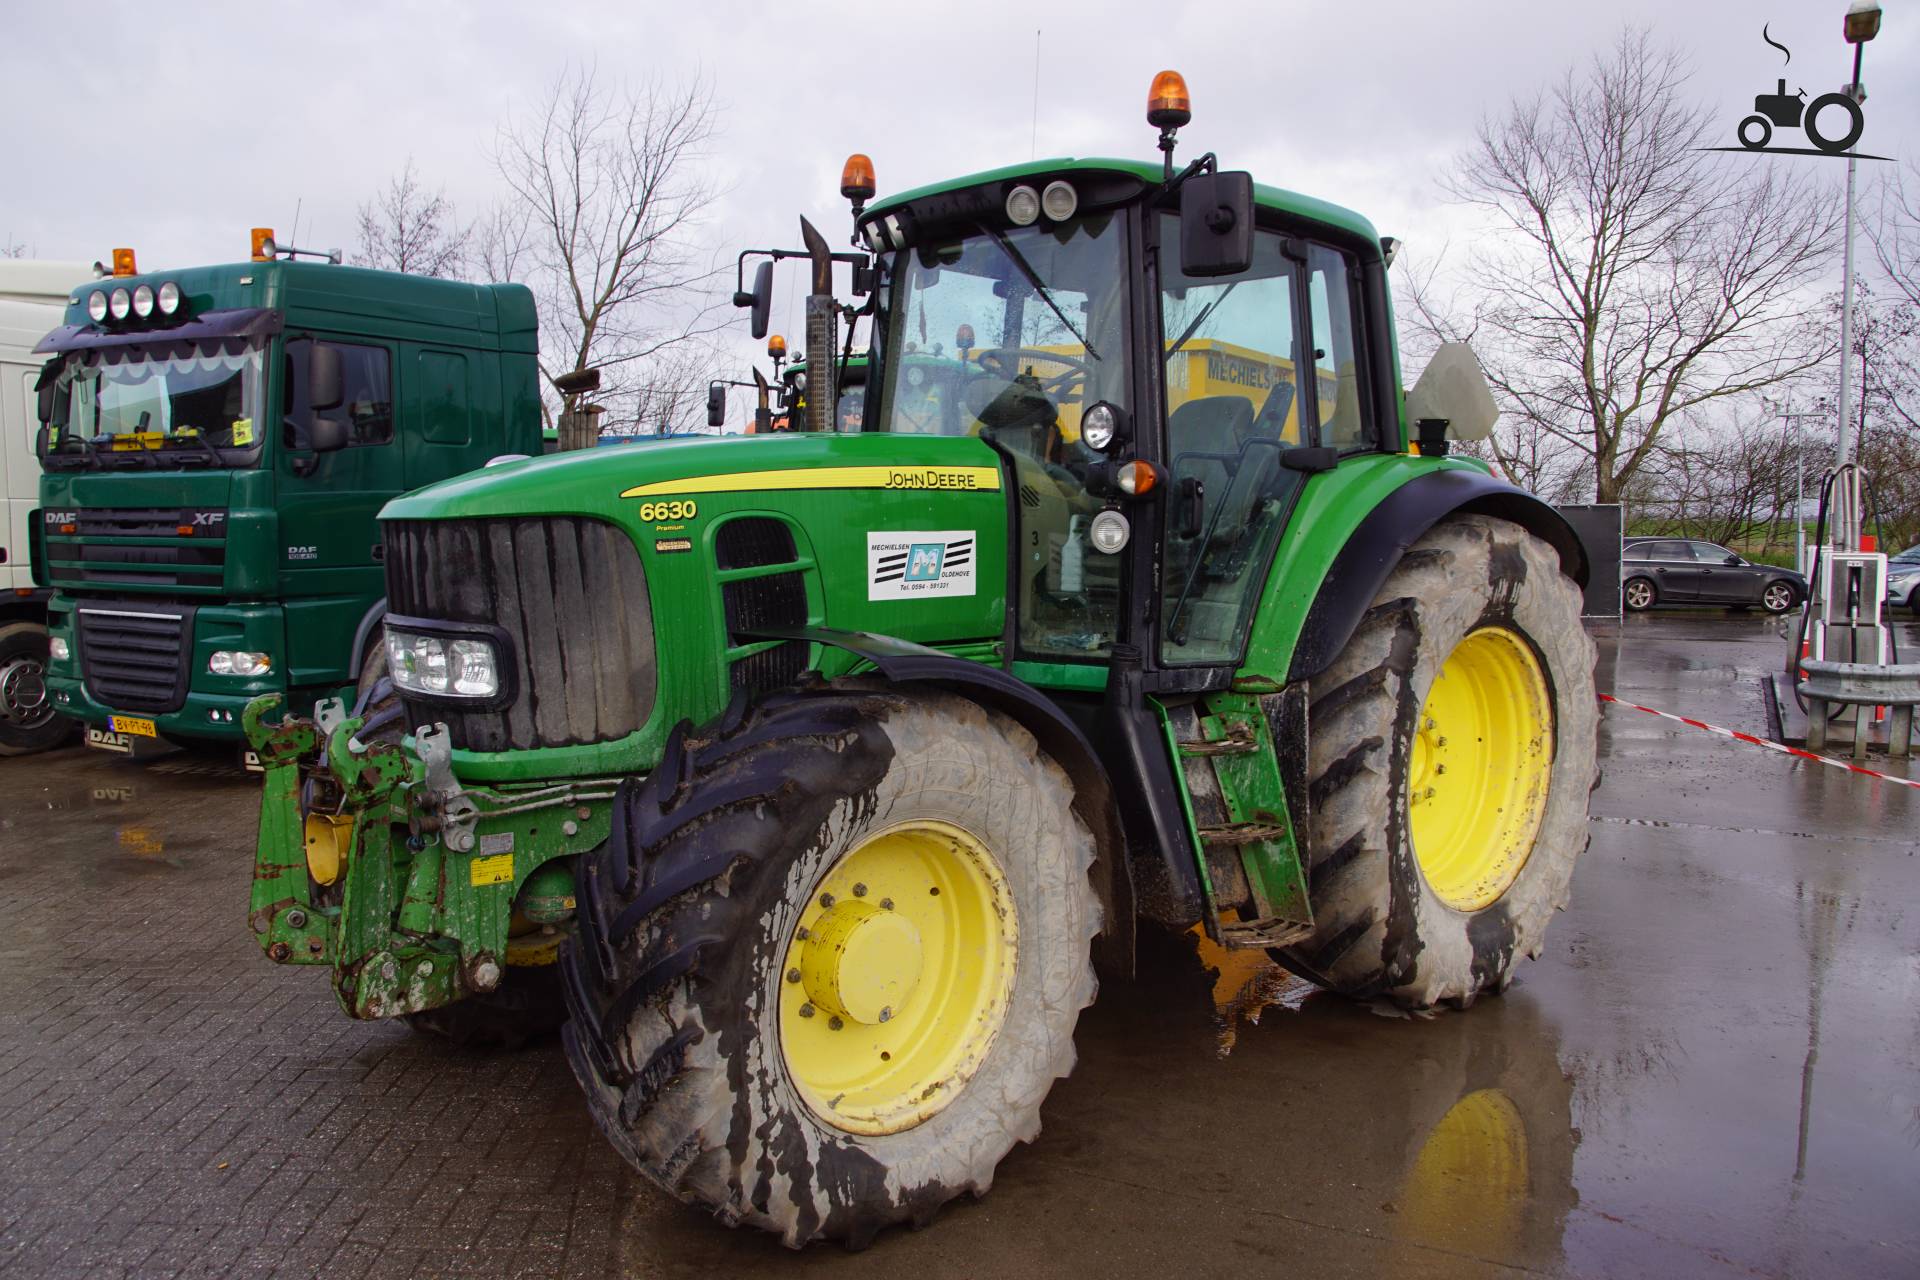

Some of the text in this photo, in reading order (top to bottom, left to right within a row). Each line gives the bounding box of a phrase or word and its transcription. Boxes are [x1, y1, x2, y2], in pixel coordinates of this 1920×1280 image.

[885, 470, 976, 487] JOHN DEERE
[45, 512, 76, 524] DAF
[191, 512, 225, 526] XF
[640, 500, 698, 522] 6630
[90, 729, 129, 745] DAF
